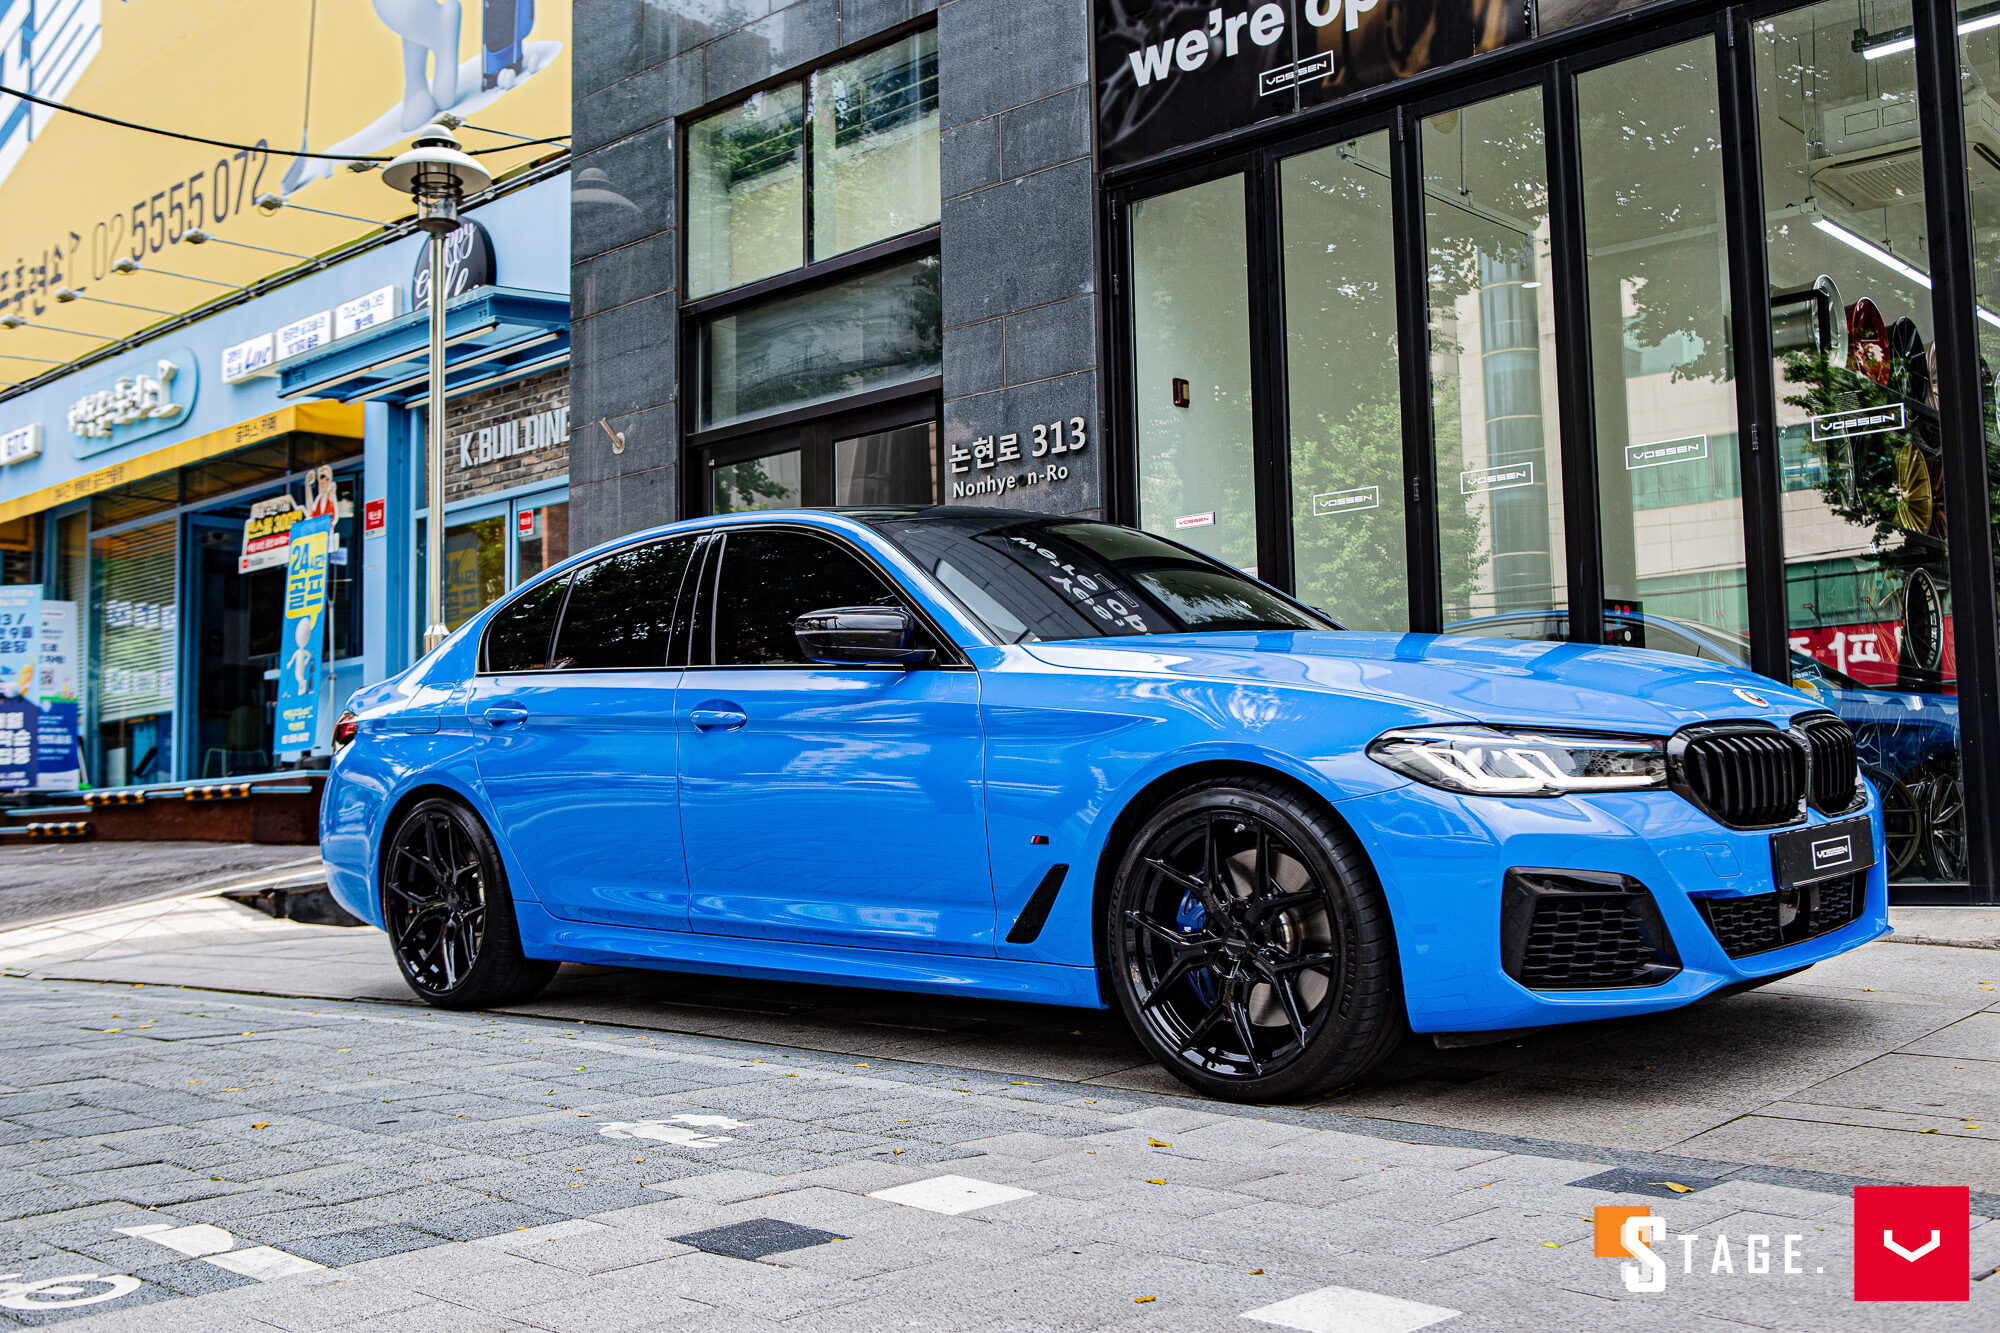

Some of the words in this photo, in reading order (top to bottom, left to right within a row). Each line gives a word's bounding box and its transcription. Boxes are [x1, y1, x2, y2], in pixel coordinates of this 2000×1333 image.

[1128, 2, 1285, 87] we're
[1265, 60, 1328, 87] VOSSEN
[213, 138, 268, 224] 072
[1820, 413, 1896, 432] VOSSEN
[949, 433, 1021, 474] 논현로
[1032, 416, 1086, 458] 313
[1633, 443, 1700, 460] VOSSEN
[953, 464, 1069, 498] Nonhyen-Ro
[1467, 470, 1527, 485] VOSSEN
[1319, 493, 1373, 508] VOSSEN
[1178, 516, 1210, 526] VOSSEN
[289, 574, 323, 611] 골프
[1816, 845, 1849, 859] VOSSEN
